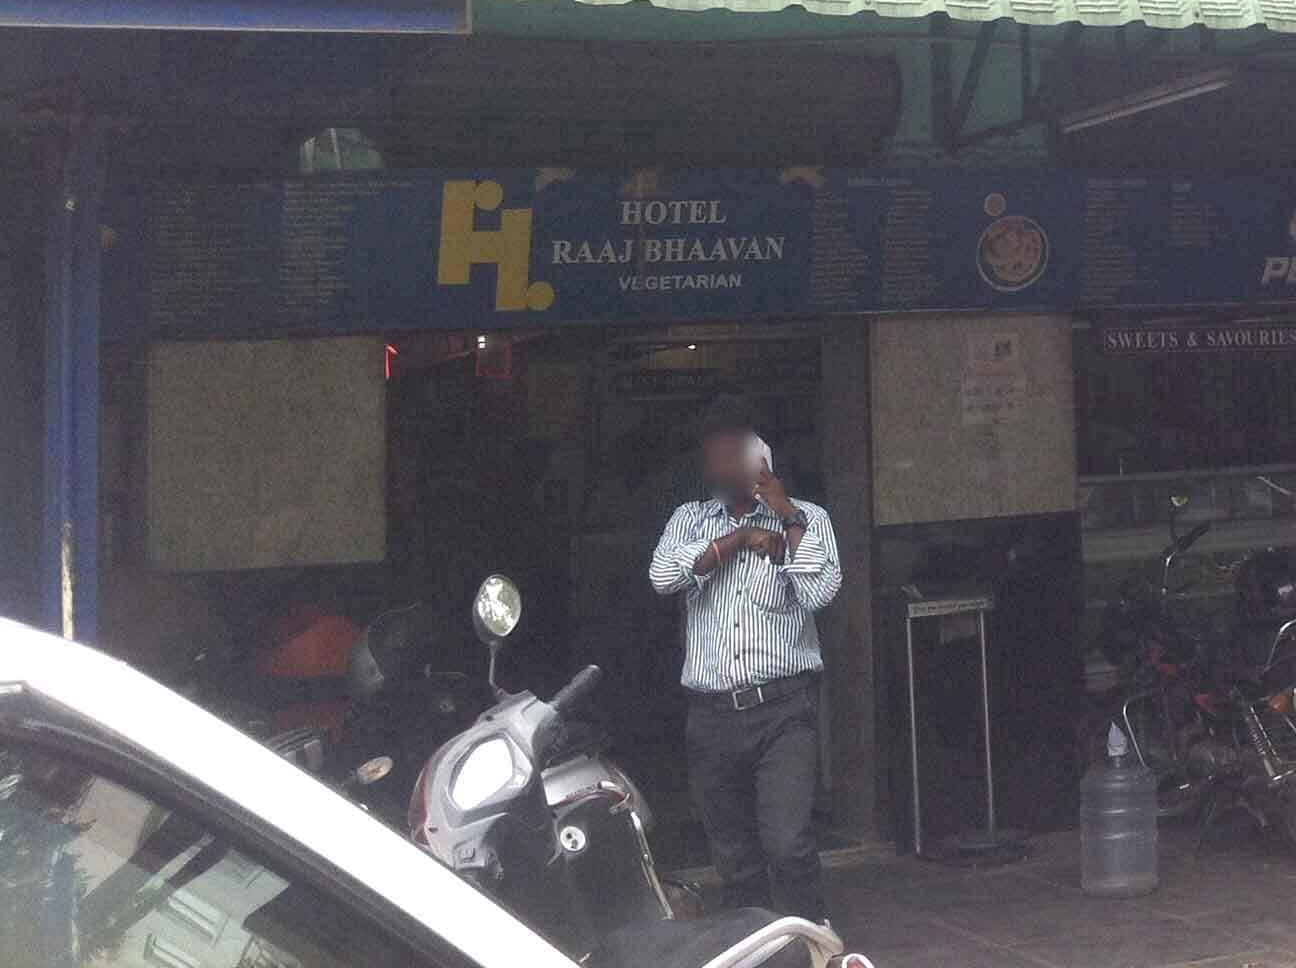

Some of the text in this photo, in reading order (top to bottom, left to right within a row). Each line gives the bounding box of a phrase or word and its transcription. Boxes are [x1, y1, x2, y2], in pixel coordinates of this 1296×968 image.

[620, 199, 727, 225] HOTEL
[552, 236, 785, 264] RAAJ BHAAVAN
[618, 274, 742, 291] VEGETARIAN
[1106, 331, 1179, 349] SWEETS
[1186, 331, 1199, 347] &
